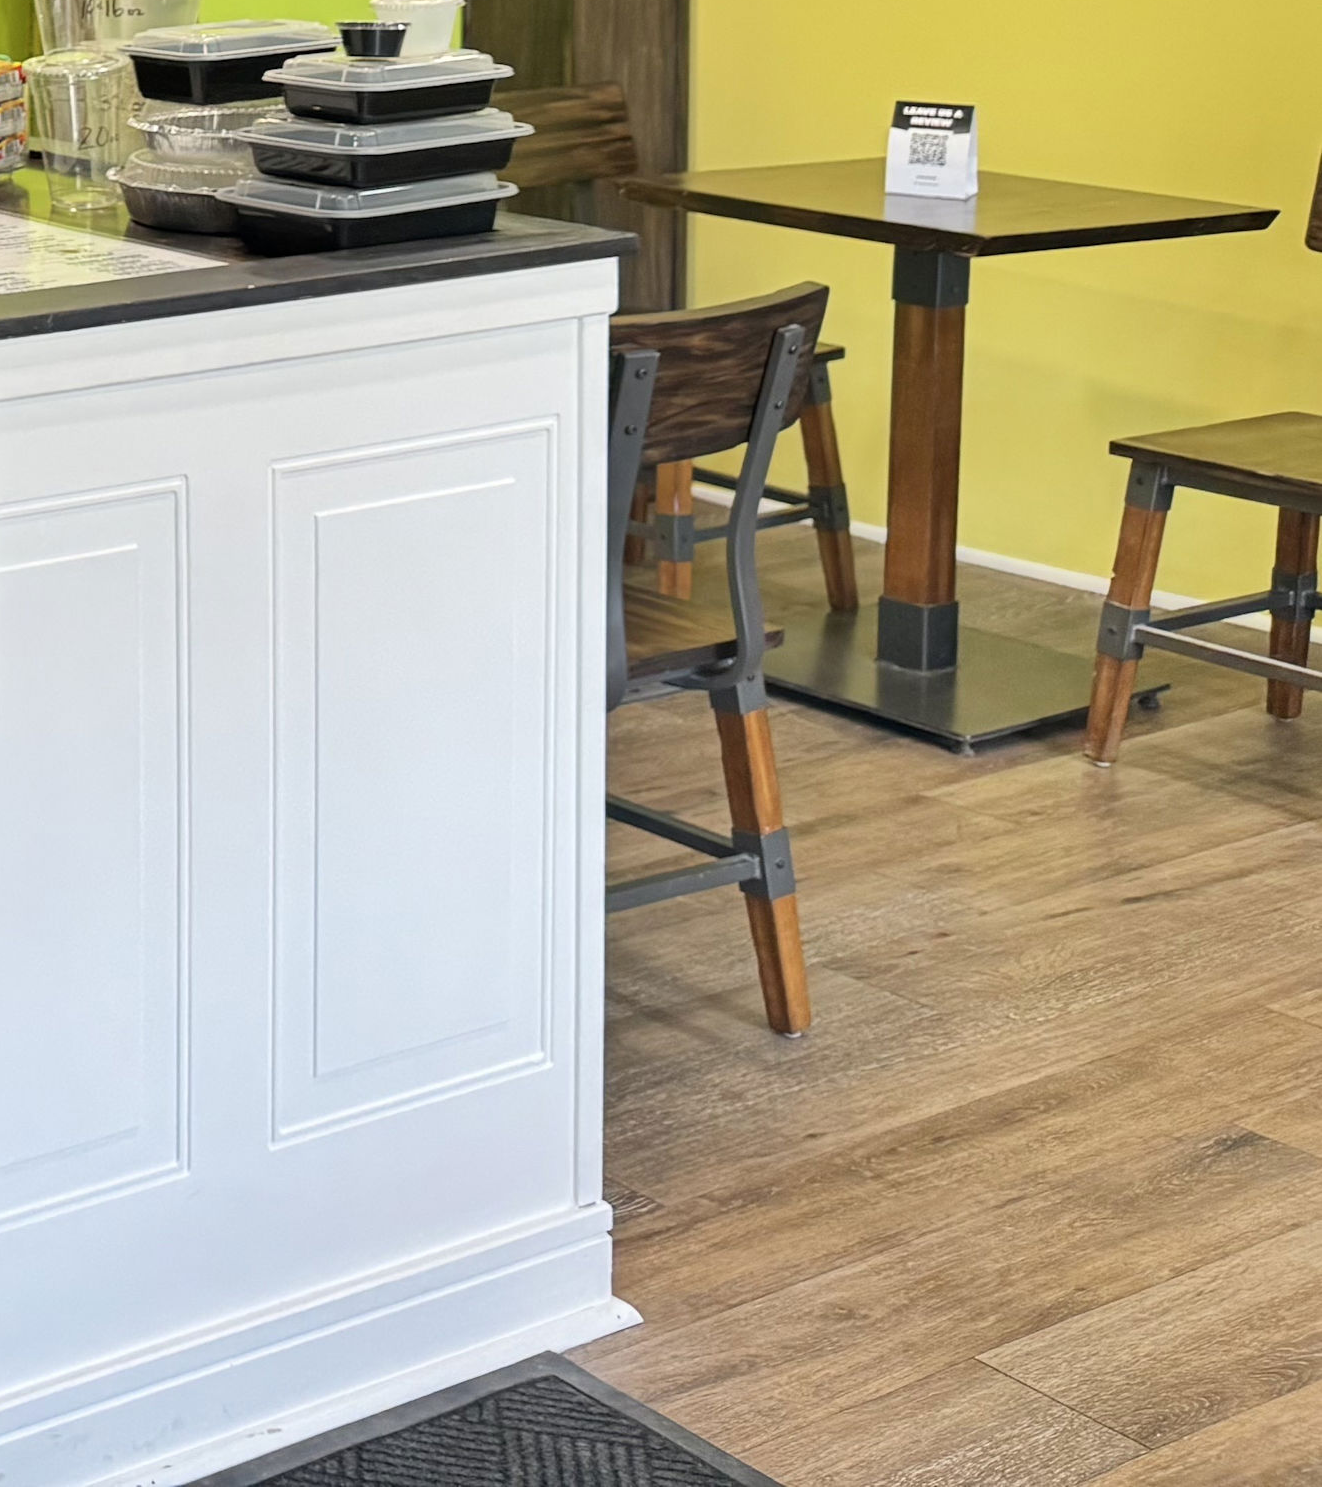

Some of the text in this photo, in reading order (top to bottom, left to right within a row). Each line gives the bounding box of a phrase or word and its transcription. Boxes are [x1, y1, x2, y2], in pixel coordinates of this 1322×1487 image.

[903, 105, 937, 117] LEAVE
[953, 109, 964, 119] A
[909, 117, 954, 128] REVIEW
